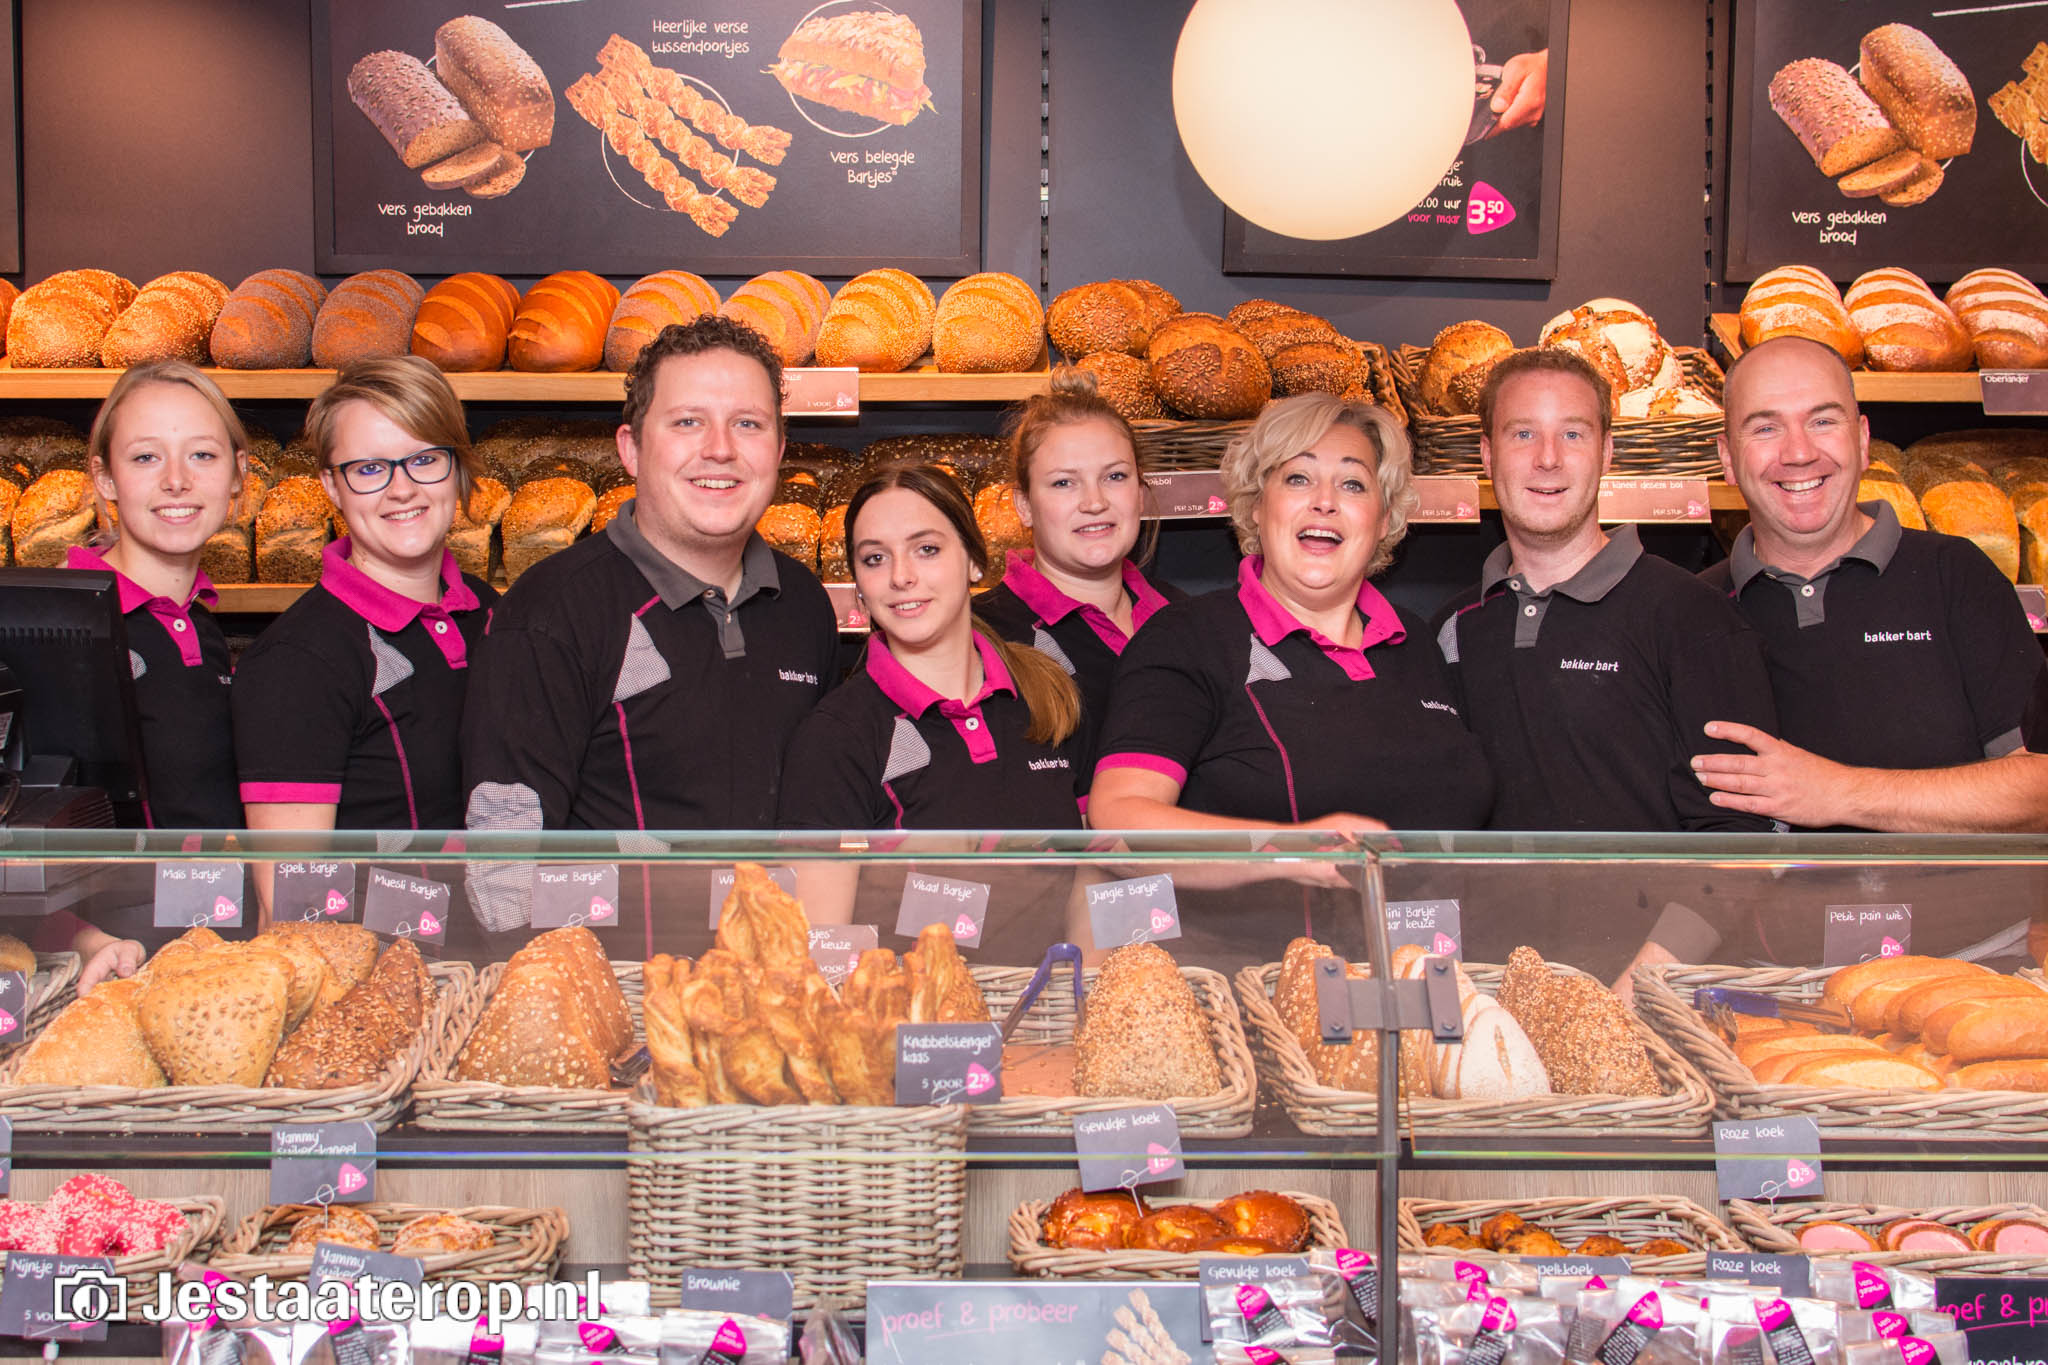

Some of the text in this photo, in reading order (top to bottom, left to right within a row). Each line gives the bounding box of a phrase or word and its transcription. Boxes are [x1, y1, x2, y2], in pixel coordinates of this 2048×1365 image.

[652, 19, 750, 39] Heerlijke verse
[652, 39, 751, 59] tussendoortjes
[864, 149, 916, 171] belegde
[1439, 175, 1464, 187] ruit
[412, 202, 473, 222] gebakken
[1443, 199, 1462, 209] uur
[1408, 213, 1461, 224] voor maar
[1825, 210, 1887, 231] gebakken
[406, 221, 445, 238] brood
[1819, 230, 1858, 246] brood
[1146, 477, 1173, 487] pitbol
[1864, 629, 1932, 643] bakker bart
[1560, 658, 1619, 672] bakker bart
[778, 668, 818, 685] bakker bat
[1028, 757, 1058, 771] bakker
[191, 868, 222, 884] Bartje
[278, 861, 339, 879] Spelt Bartje
[538, 870, 603, 886] Tarwe Bartje
[374, 873, 439, 900] Muesli Bartje
[718, 873, 735, 885] Wi
[912, 879, 972, 902] Vitaal Bartje
[1091, 882, 1159, 905] Jungle Bartje
[1405, 905, 1436, 921] Bartje
[1859, 909, 1882, 926] pain
[1885, 909, 1904, 921] wit
[1405, 918, 1436, 929] keuze
[821, 940, 852, 951] keuze
[903, 1034, 992, 1056] Knabbelstengel
[903, 1050, 931, 1064] kaas
[921, 1077, 930, 1089] 5
[1079, 1111, 1161, 1135] Gevulde koek
[1719, 1123, 1785, 1140] Roze koek
[276, 1131, 321, 1150] Yammy
[10, 1258, 54, 1279] Nijntje
[320, 1247, 367, 1277] Yammy
[1712, 1257, 1782, 1274] Roze koek
[1208, 1264, 1298, 1280] Gevulde koek
[1537, 1262, 1594, 1280] peltkoek
[687, 1274, 741, 1291] Brownie
[23, 1308, 32, 1320] 5
[1937, 1293, 1987, 1321] roef
[2000, 1293, 2021, 1319] &
[880, 1299, 1080, 1348] proef & probeer
